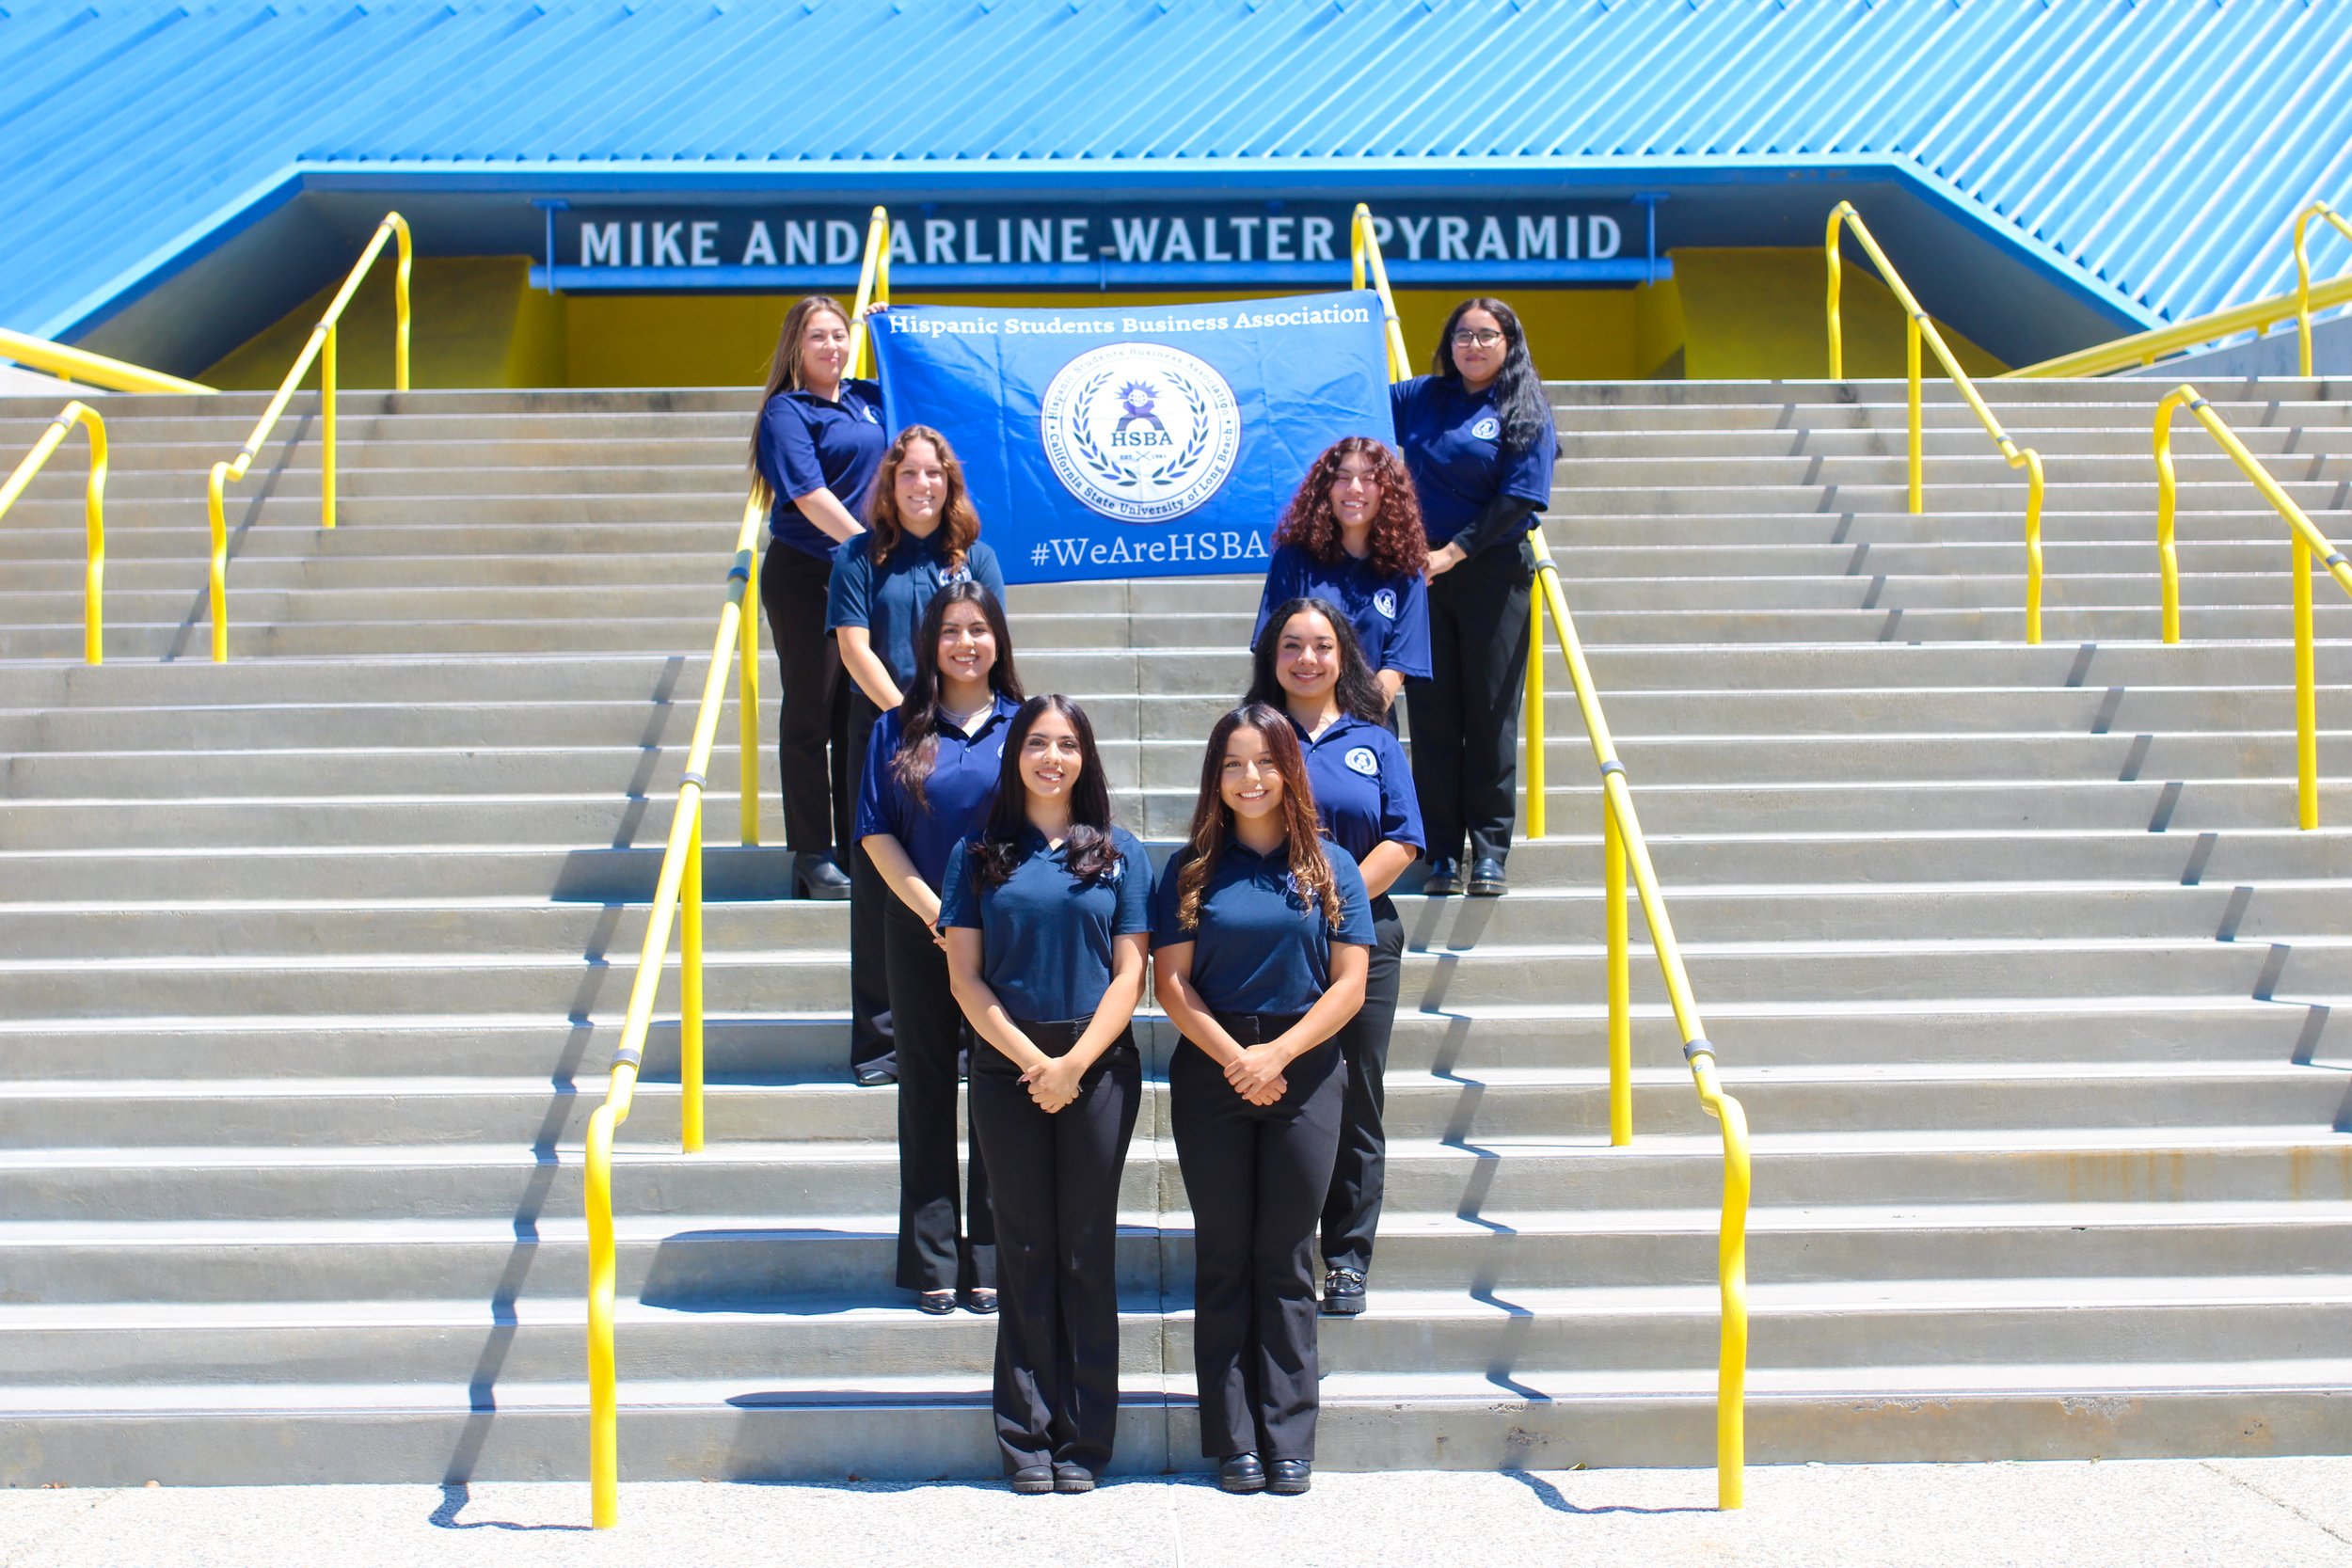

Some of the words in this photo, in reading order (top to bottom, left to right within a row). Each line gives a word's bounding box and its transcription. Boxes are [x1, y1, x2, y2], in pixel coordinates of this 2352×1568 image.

[580, 221, 720, 267] MIKE
[741, 220, 859, 265] AND
[889, 218, 1089, 264] ARLINE
[1111, 216, 1335, 262] WALTER
[889, 314, 998, 338] Hispanic
[1004, 316, 1115, 335] Students
[1122, 314, 1229, 333] Business
[1233, 305, 1370, 329] Association
[1048, 374, 1073, 420] Hispanic
[1073, 350, 1124, 373] Students
[1130, 348, 1183, 364] Business
[1187, 362, 1230, 416] Association
[1111, 431, 1173, 447] HSBA
[1050, 433, 1082, 489] California
[1084, 486, 1115, 509] State
[1120, 498, 1184, 516] University
[1187, 489, 1199, 501] of
[1199, 466, 1225, 491] Long
[1217, 427, 1233, 463] Beach
[1030, 530, 1269, 567] #WeAreHSBA
